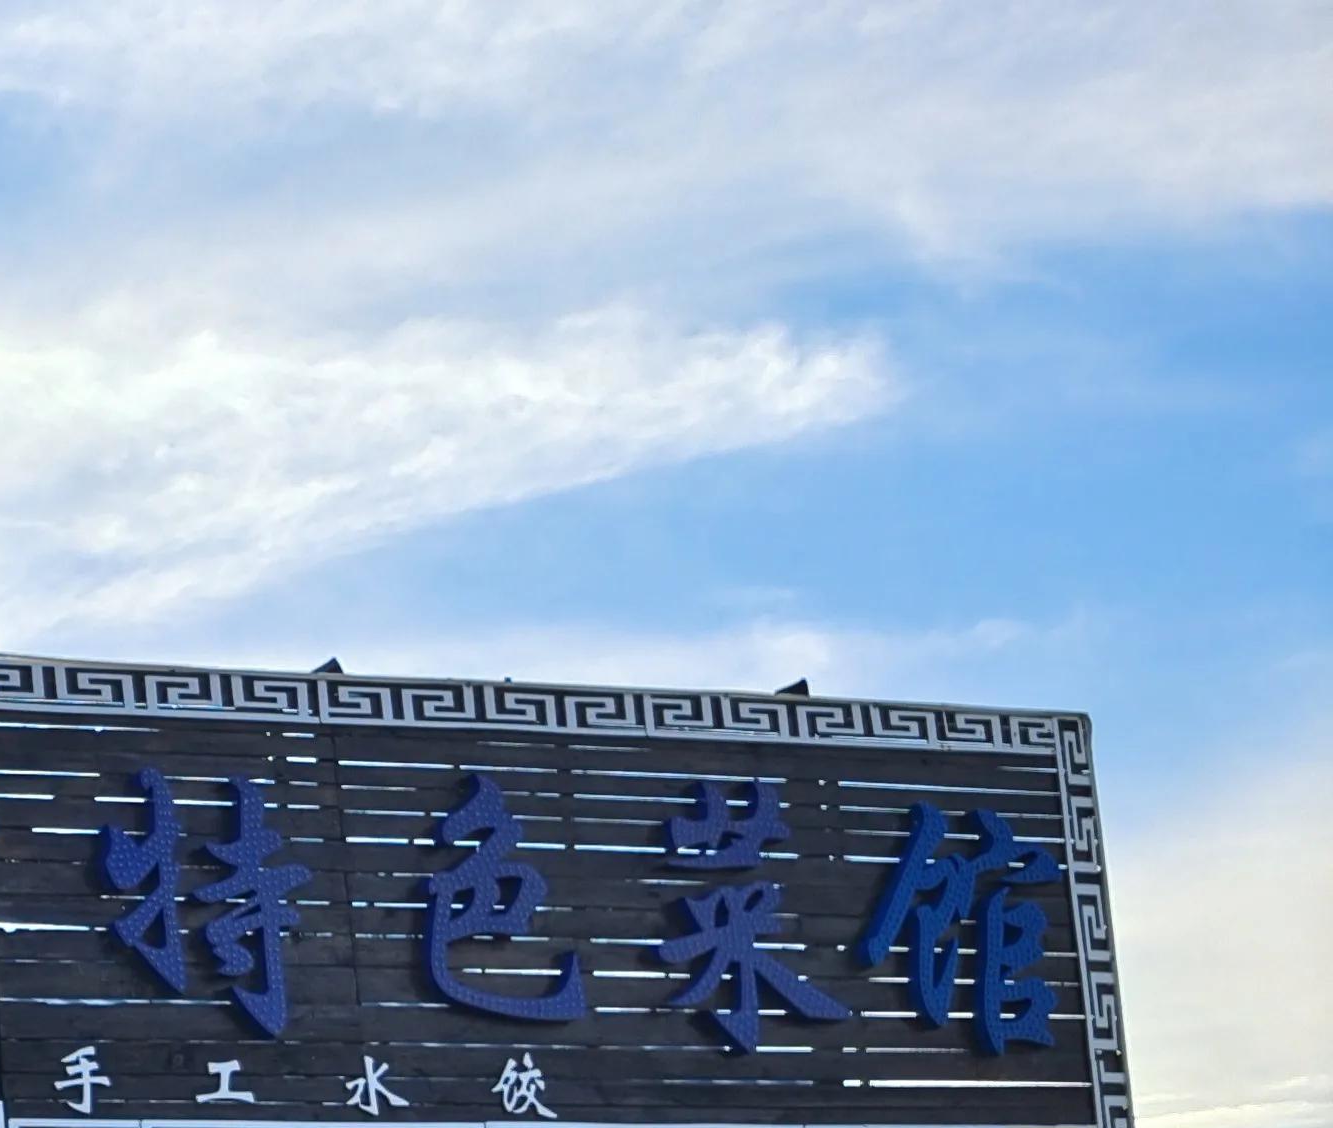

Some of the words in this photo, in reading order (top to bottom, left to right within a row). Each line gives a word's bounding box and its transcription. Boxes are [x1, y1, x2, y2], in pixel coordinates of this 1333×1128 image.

[97, 766, 1065, 1056] 特色菜馆
[53, 1044, 559, 1120] 手工水饺
